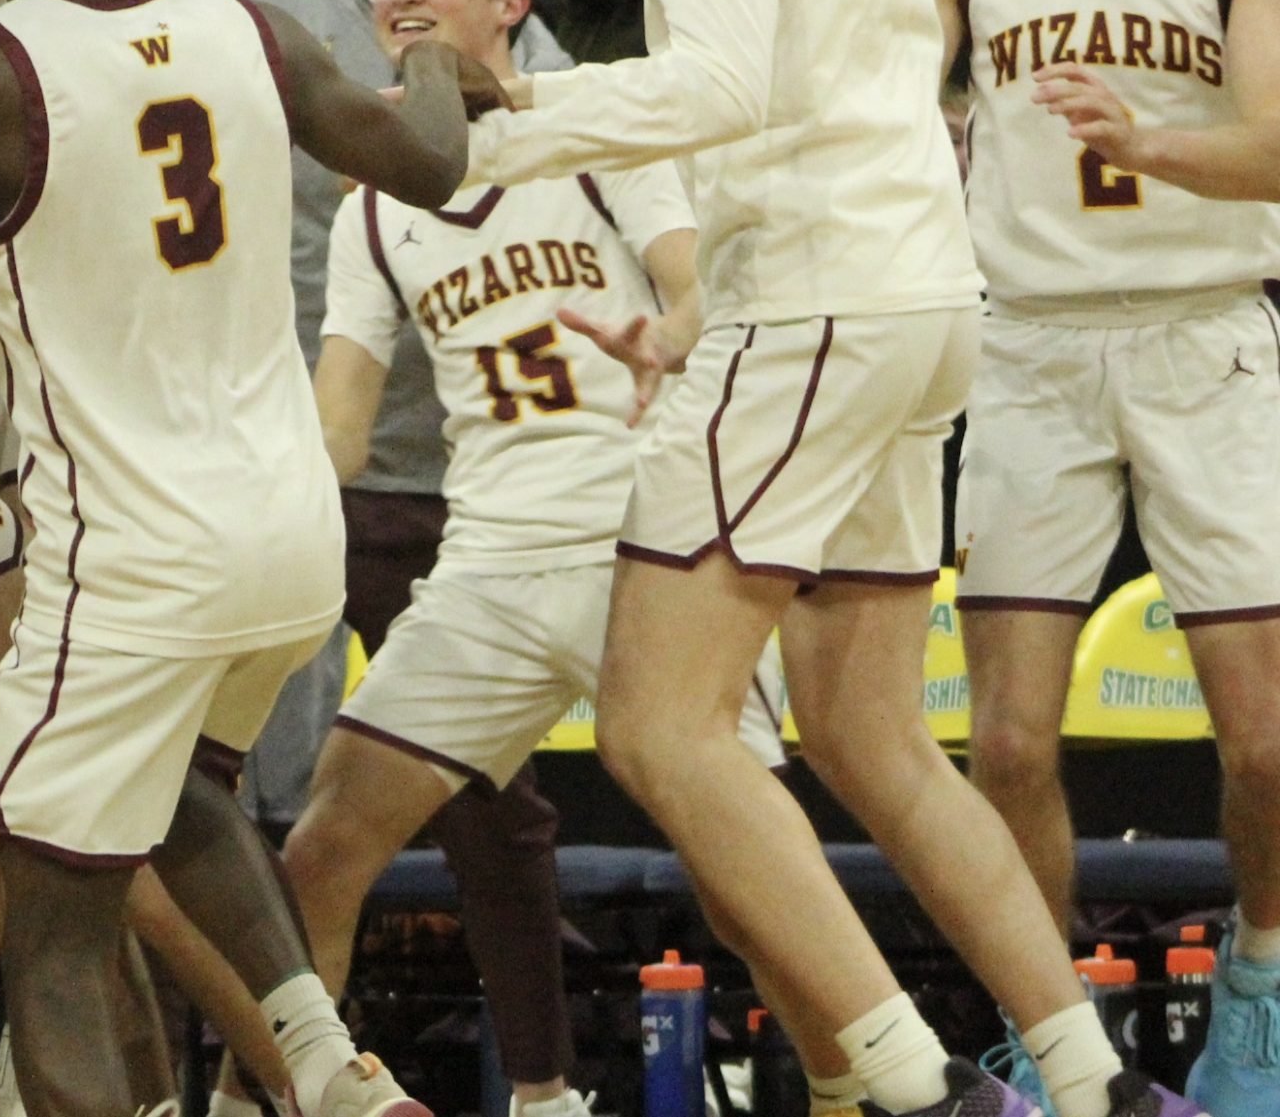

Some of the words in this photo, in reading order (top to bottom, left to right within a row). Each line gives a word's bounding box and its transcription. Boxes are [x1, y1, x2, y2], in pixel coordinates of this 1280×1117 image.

[129, 34, 172, 67] W
[987, 10, 1223, 88] WIZARDS
[133, 94, 229, 276] 3
[474, 320, 581, 425] 15
[1100, 668, 1157, 707] STATE
